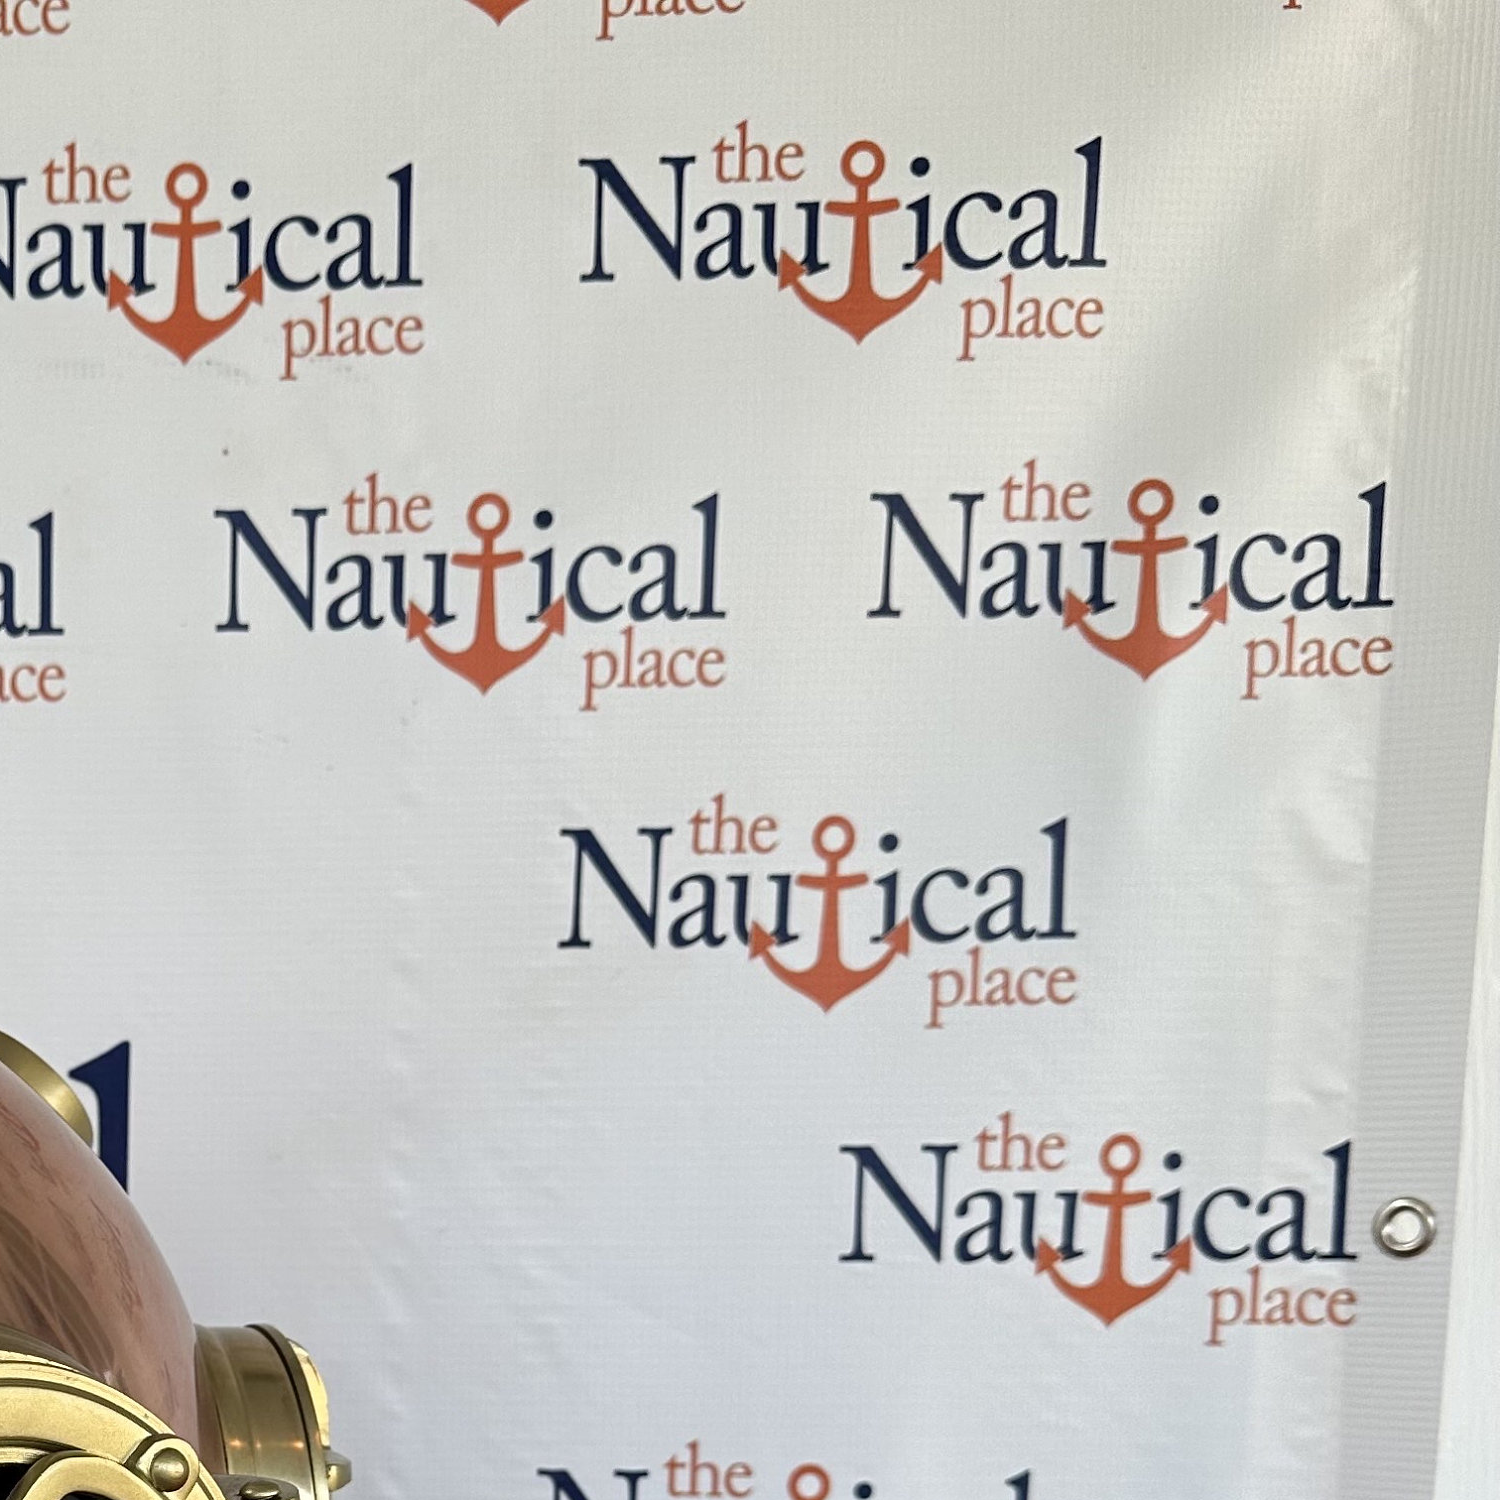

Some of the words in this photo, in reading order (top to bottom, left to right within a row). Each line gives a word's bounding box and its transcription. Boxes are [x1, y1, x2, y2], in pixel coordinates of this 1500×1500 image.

[40, 141, 133, 206] the
[712, 118, 808, 185] the
[579, 136, 1106, 345] Nautical
[281, 292, 426, 382] place
[956, 273, 1106, 363] place
[343, 471, 433, 537] the
[1001, 458, 1093, 523] the
[215, 494, 725, 695] Nautical
[867, 482, 1393, 682] Nautical
[582, 623, 727, 713] place
[1243, 617, 1395, 700] place
[690, 792, 780, 857] the
[559, 818, 1076, 1012] Nautical
[928, 946, 1079, 1029] place
[977, 1111, 1067, 1172] the
[840, 1142, 1357, 1325] Nautical
[1210, 1266, 1357, 1347] place
[665, 1439, 753, 1499] the
